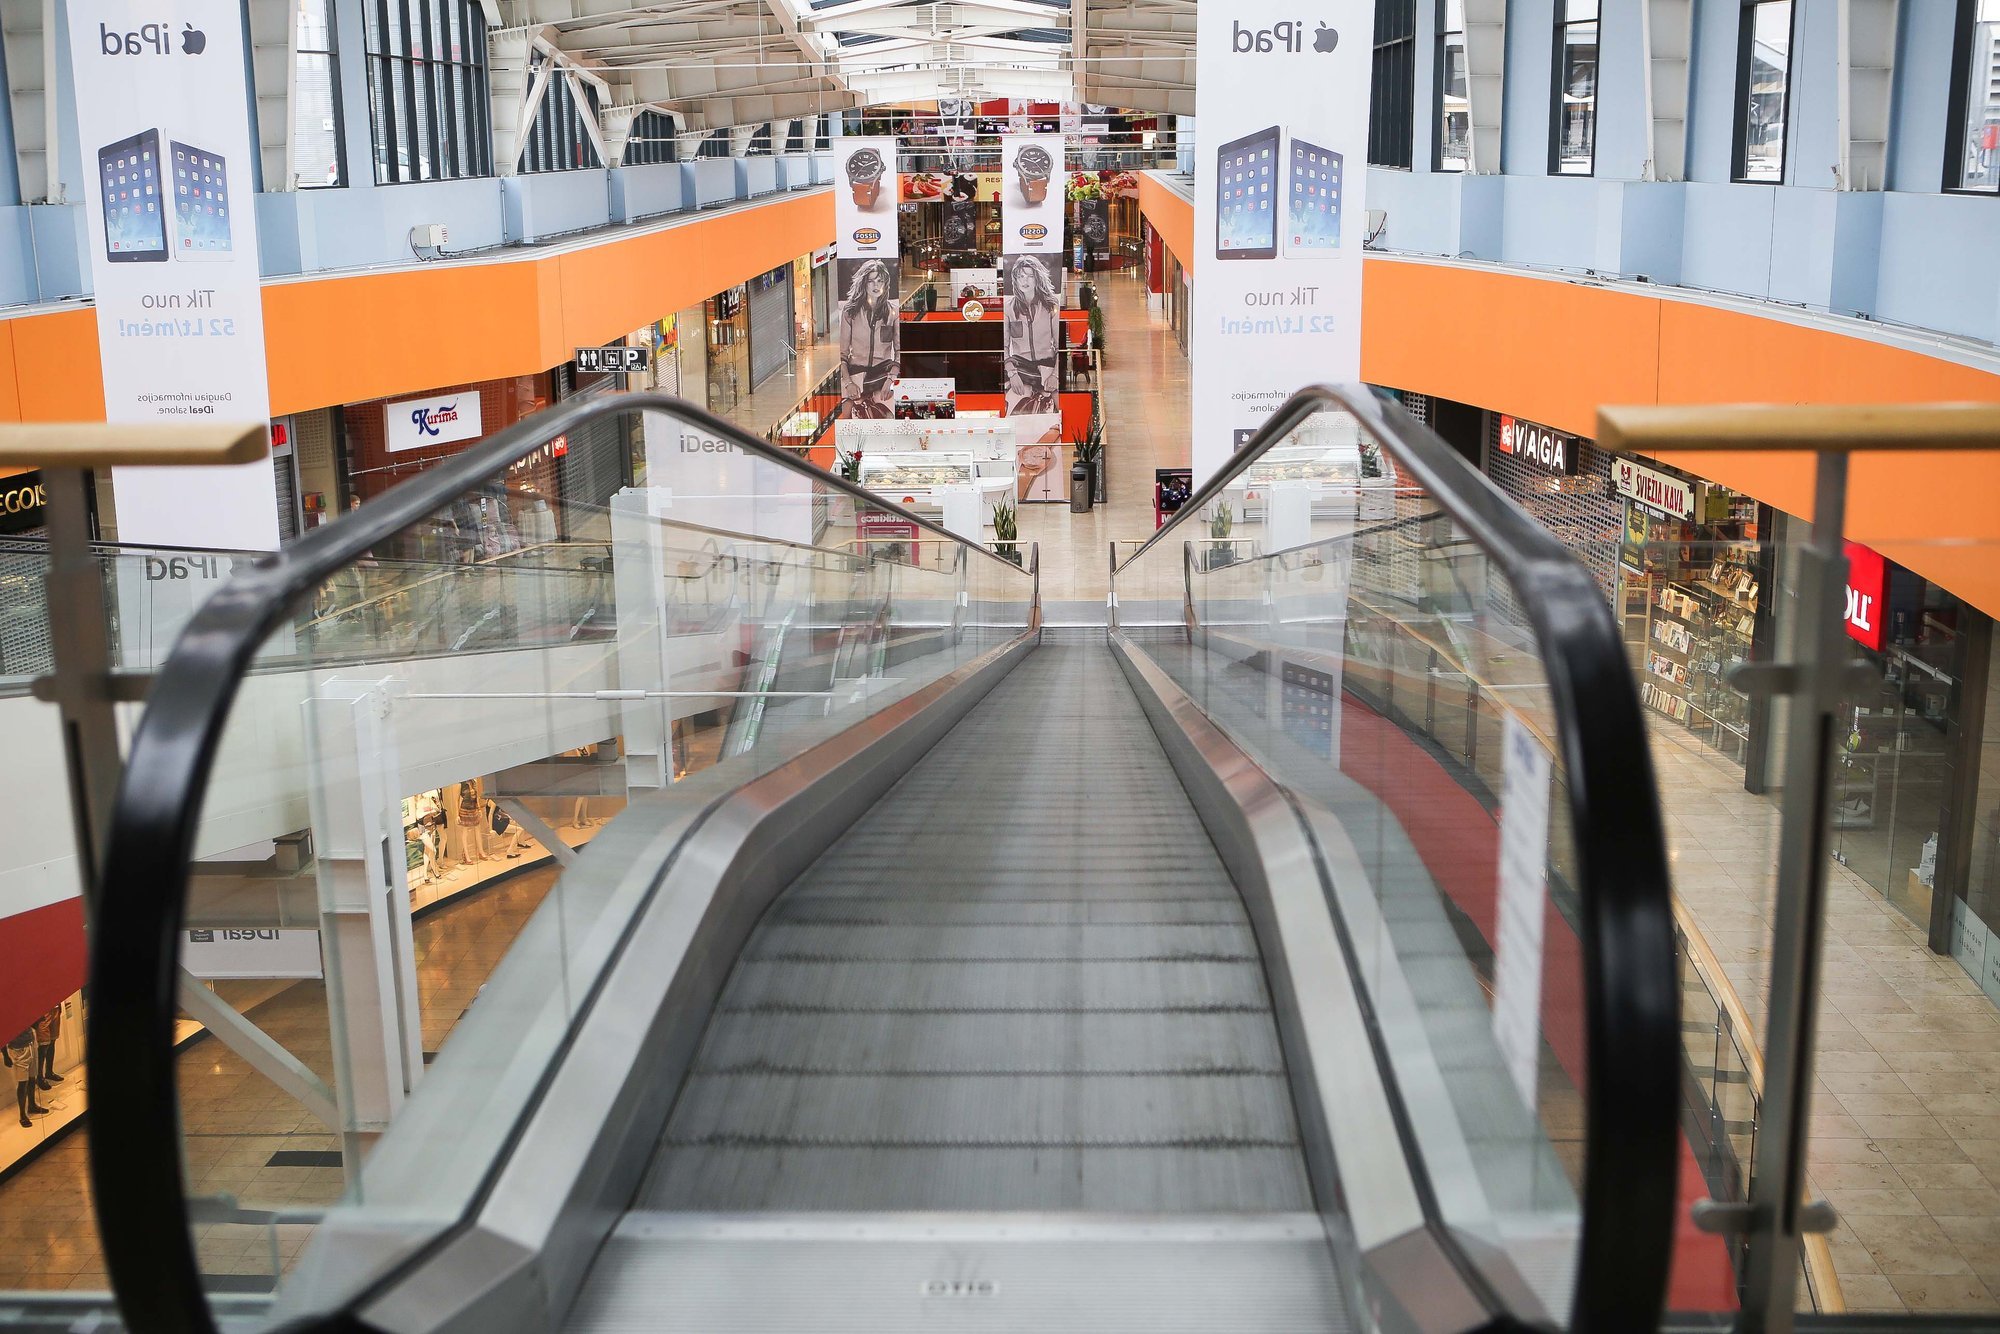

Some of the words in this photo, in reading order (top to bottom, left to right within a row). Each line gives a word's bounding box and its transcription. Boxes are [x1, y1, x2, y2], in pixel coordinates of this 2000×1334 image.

[625, 350, 639, 366] P
[1515, 424, 1564, 470] VAGA
[1635, 466, 1663, 506] ŠVIEŽIA
[1664, 484, 1684, 514] KAVA
